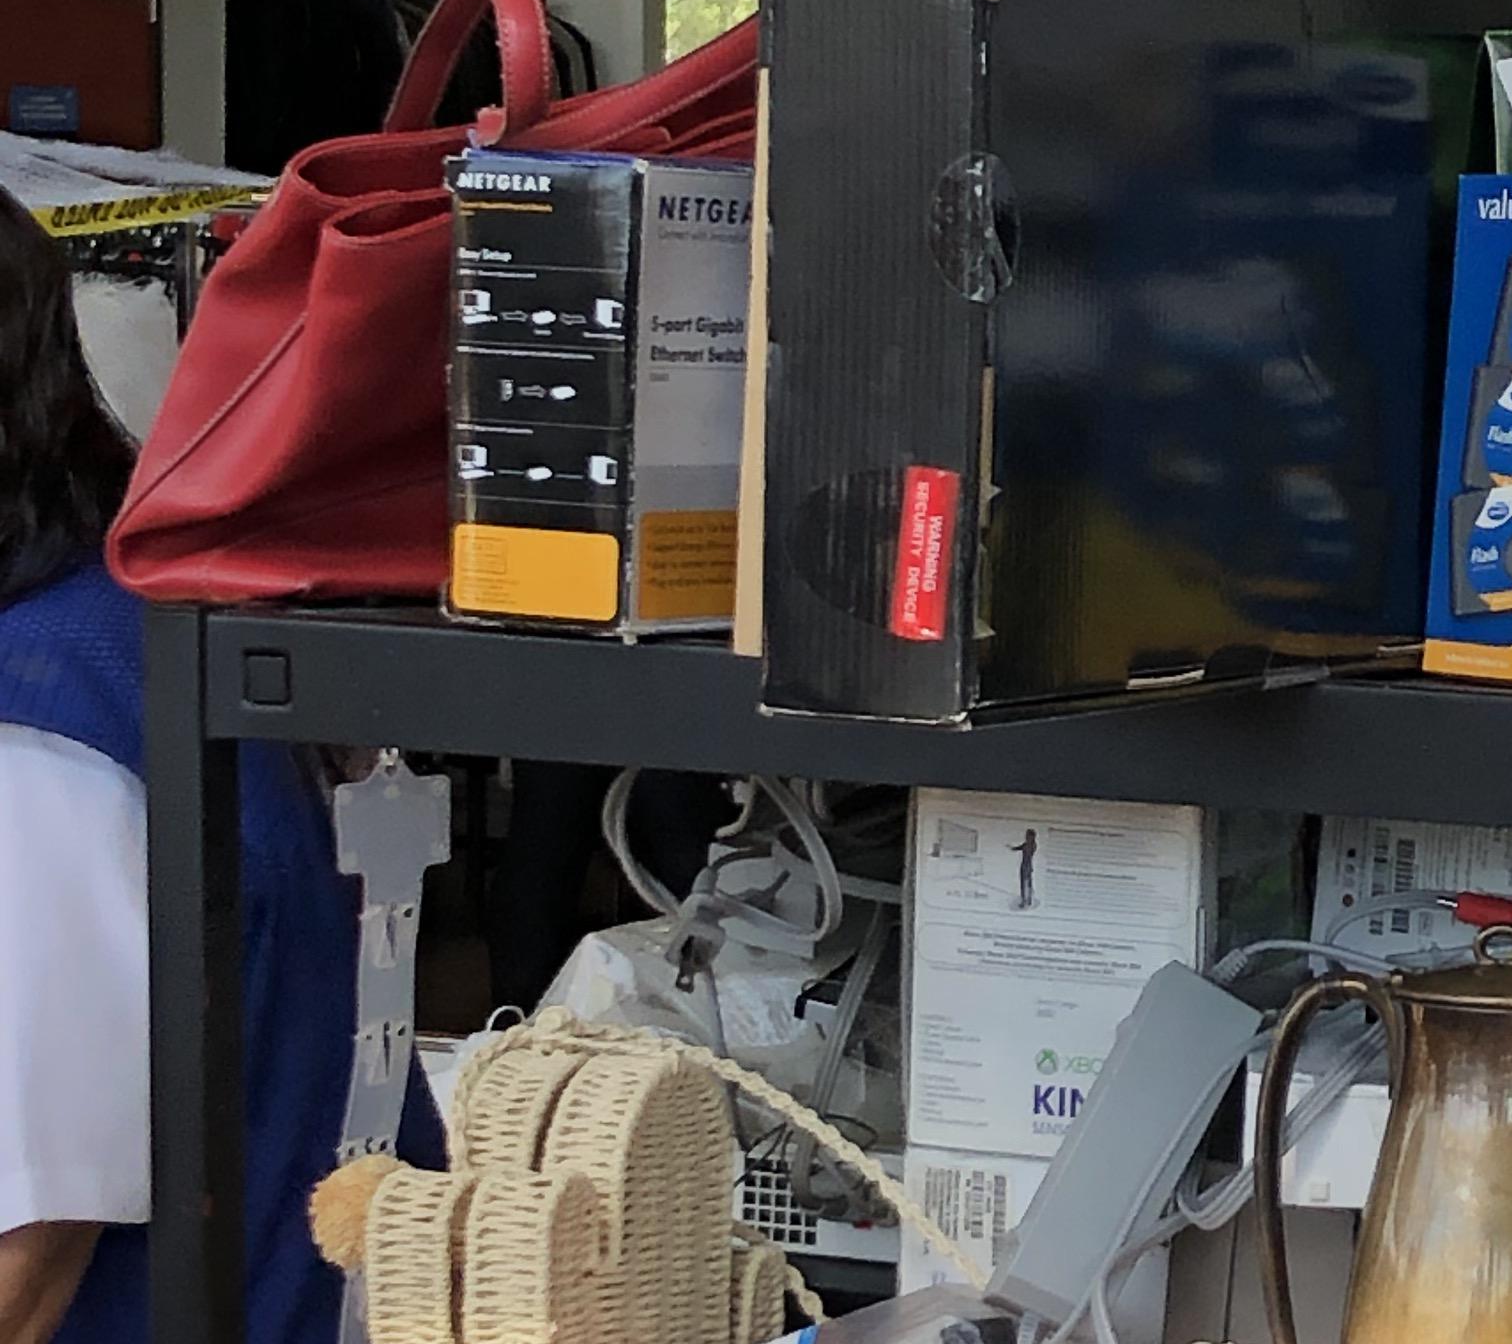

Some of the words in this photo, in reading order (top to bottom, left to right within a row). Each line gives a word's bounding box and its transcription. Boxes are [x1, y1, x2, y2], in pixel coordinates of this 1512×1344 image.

[456, 172, 552, 193] NETGEAR
[910, 481, 930, 557] SECURITY
[922, 515, 944, 592] WARNING
[902, 566, 921, 623] DEVICE
